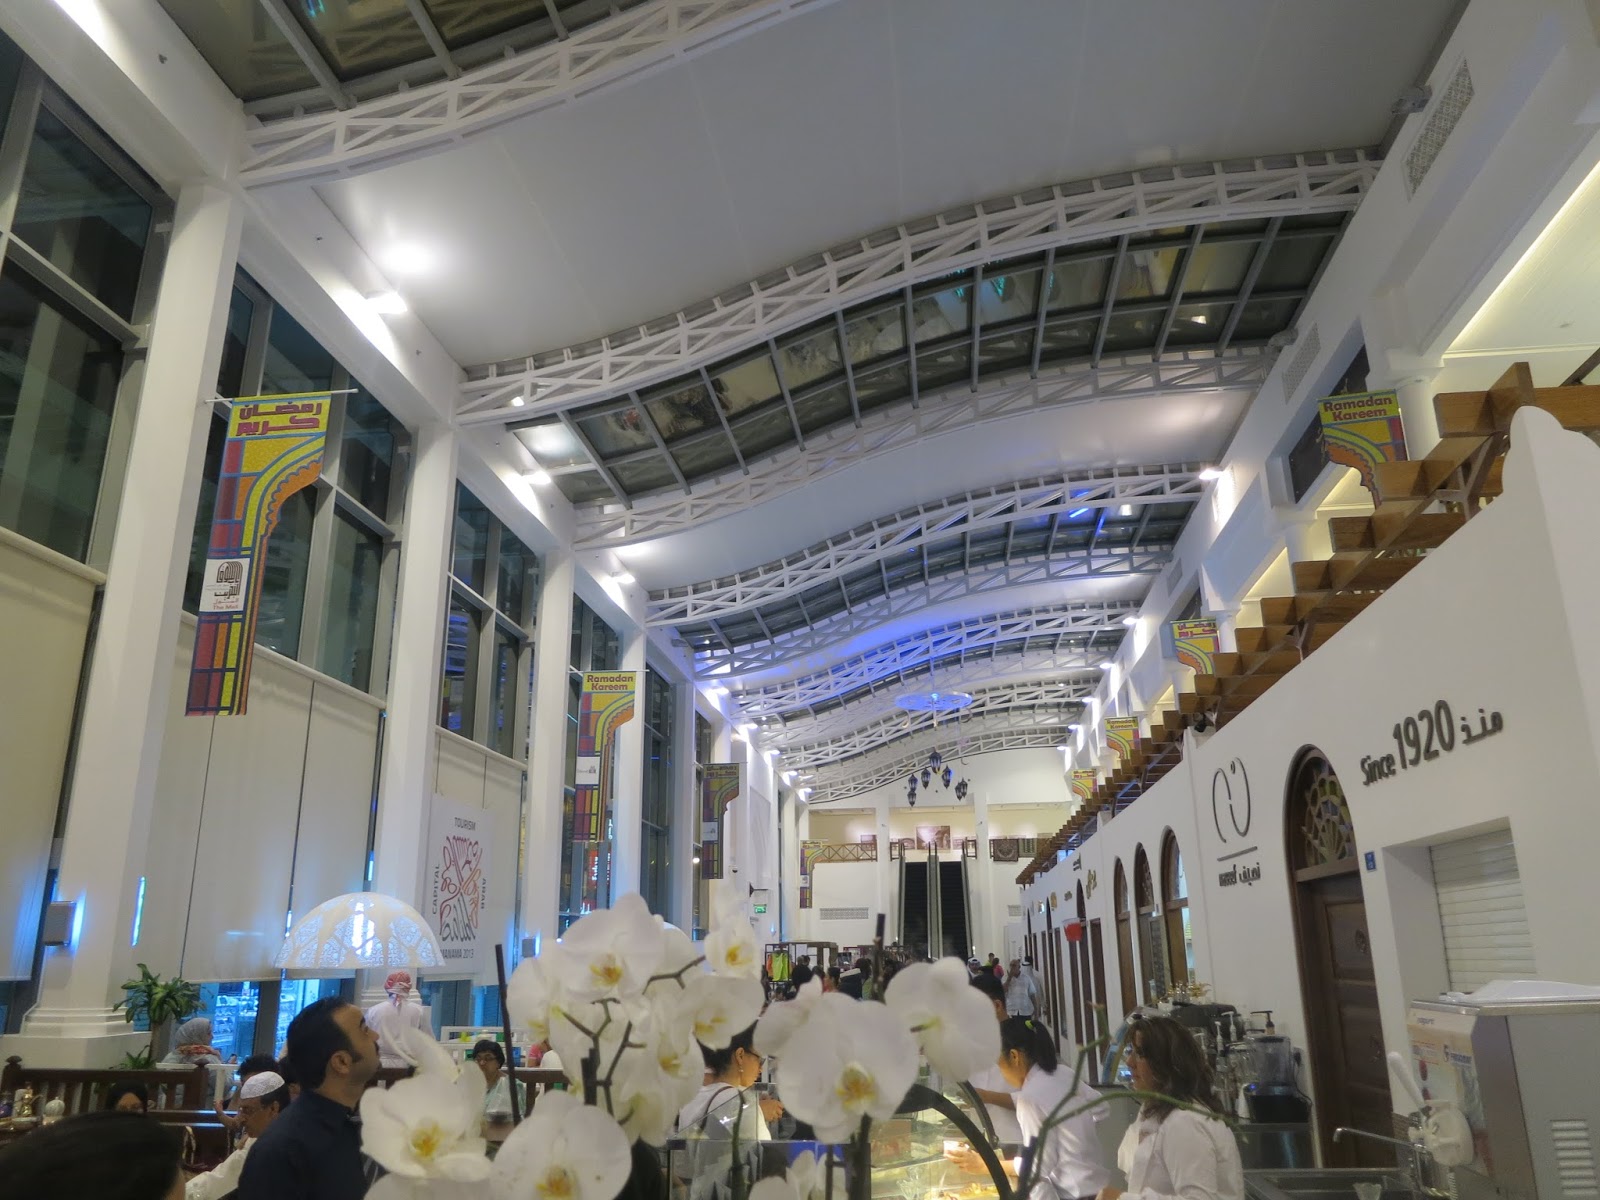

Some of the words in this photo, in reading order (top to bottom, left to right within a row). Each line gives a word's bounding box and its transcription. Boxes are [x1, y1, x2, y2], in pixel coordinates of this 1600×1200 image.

[239, 401, 322, 420] رمضان
[1323, 396, 1392, 413] Ramadan
[1332, 408, 1387, 421] Kareem
[236, 415, 319, 436] كريم
[587, 674, 634, 683] Ramadan
[591, 683, 628, 691] Kareem
[1360, 754, 1396, 786] Since
[1393, 699, 1455, 770] 1920
[1461, 708, 1503, 745] منذ
[454, 817, 476, 831] TOURISM
[432, 863, 441, 915] CAPITAL
